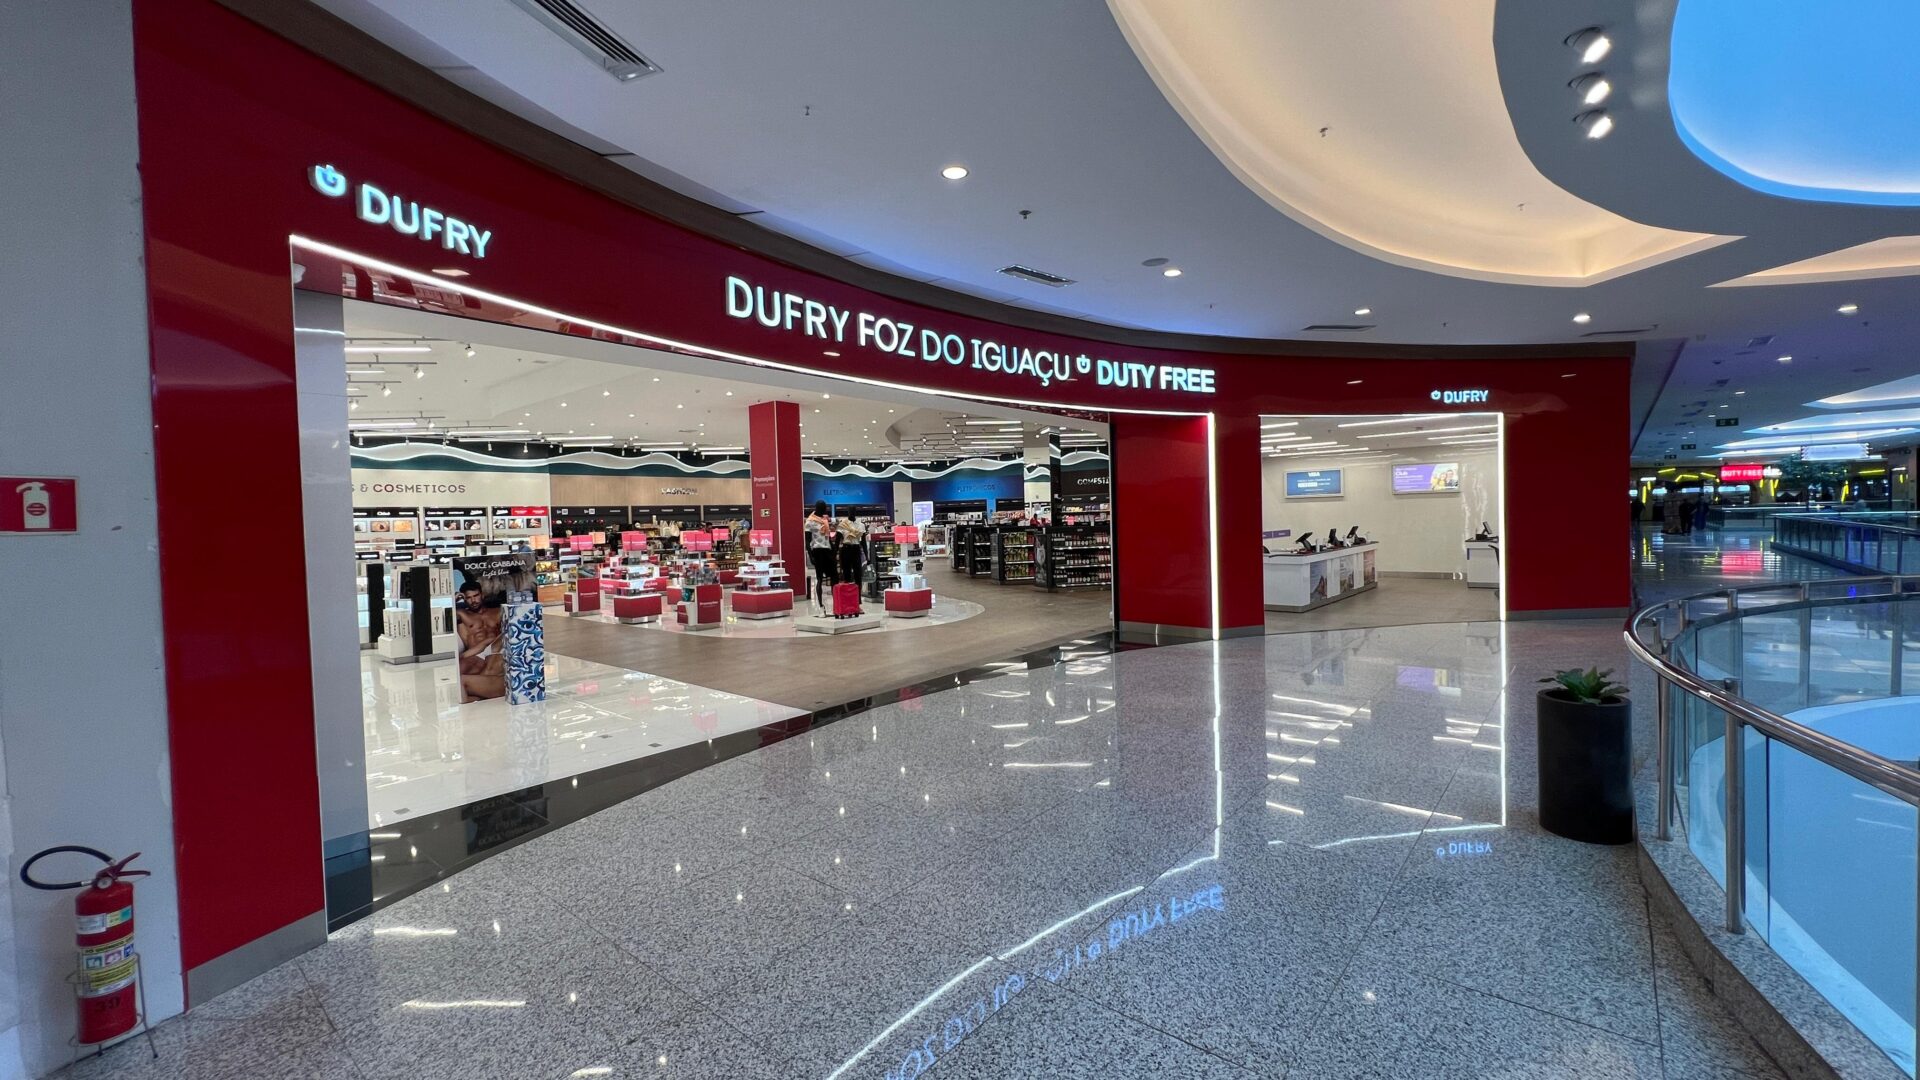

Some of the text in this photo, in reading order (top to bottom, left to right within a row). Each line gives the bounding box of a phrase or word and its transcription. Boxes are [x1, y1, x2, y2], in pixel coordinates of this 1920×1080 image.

[356, 183, 491, 258] DUFRY
[725, 275, 1216, 393] DUFRY FOZ DO IGUAÇU DUTY FREE
[1443, 390, 1489, 404] DUFRY
[360, 484, 369, 493] &
[373, 483, 466, 494] COSMETICOS
[464, 562, 488, 570] DOLCE
[491, 559, 526, 568] GABBANA
